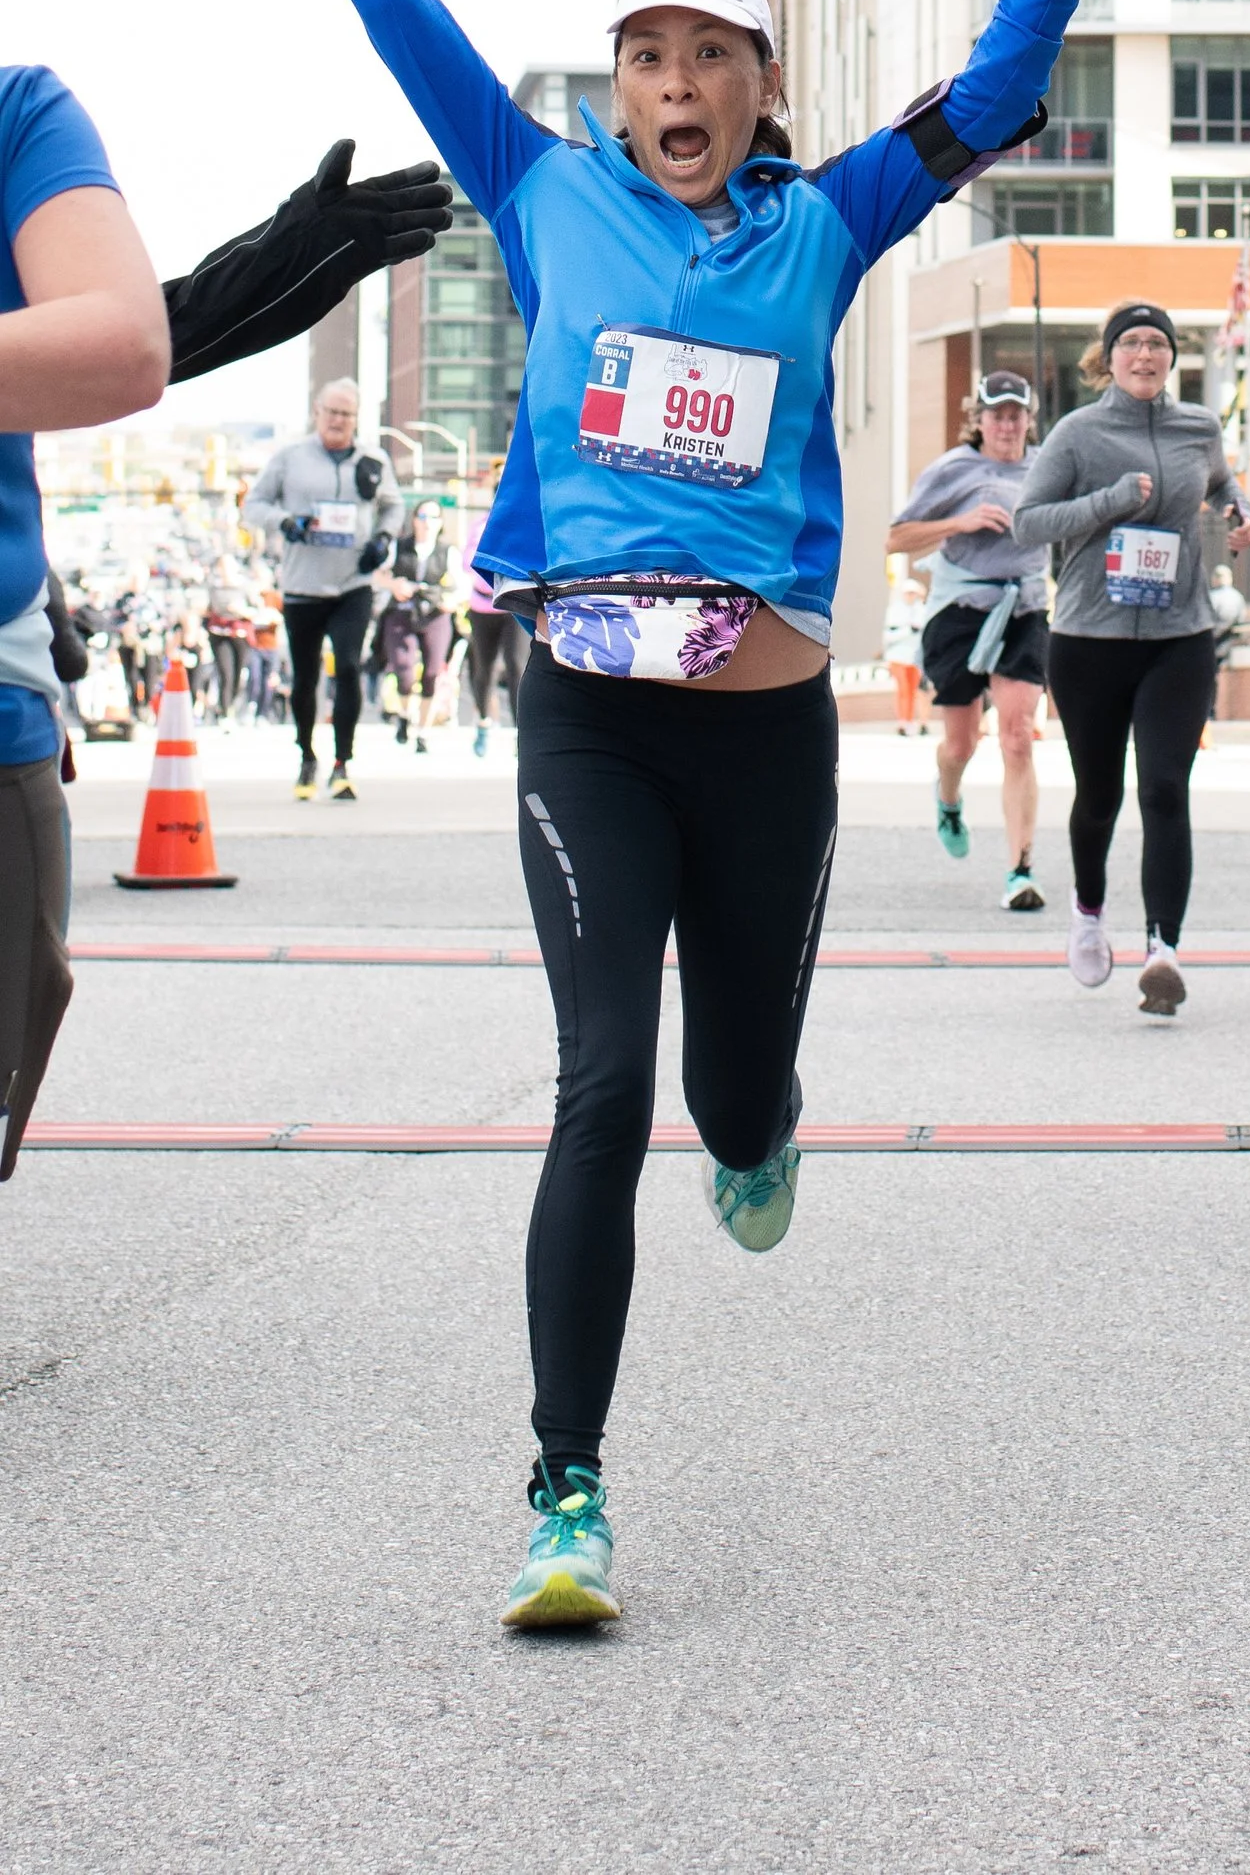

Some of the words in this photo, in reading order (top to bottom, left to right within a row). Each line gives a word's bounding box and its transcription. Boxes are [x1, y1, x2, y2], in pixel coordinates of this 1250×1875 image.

[604, 332, 628, 344] 2023
[595, 344, 630, 361] CORRAL
[601, 359, 617, 385] B
[663, 385, 735, 438] 990
[662, 432, 725, 458] KRISTEN
[1137, 549, 1170, 569] 1687
